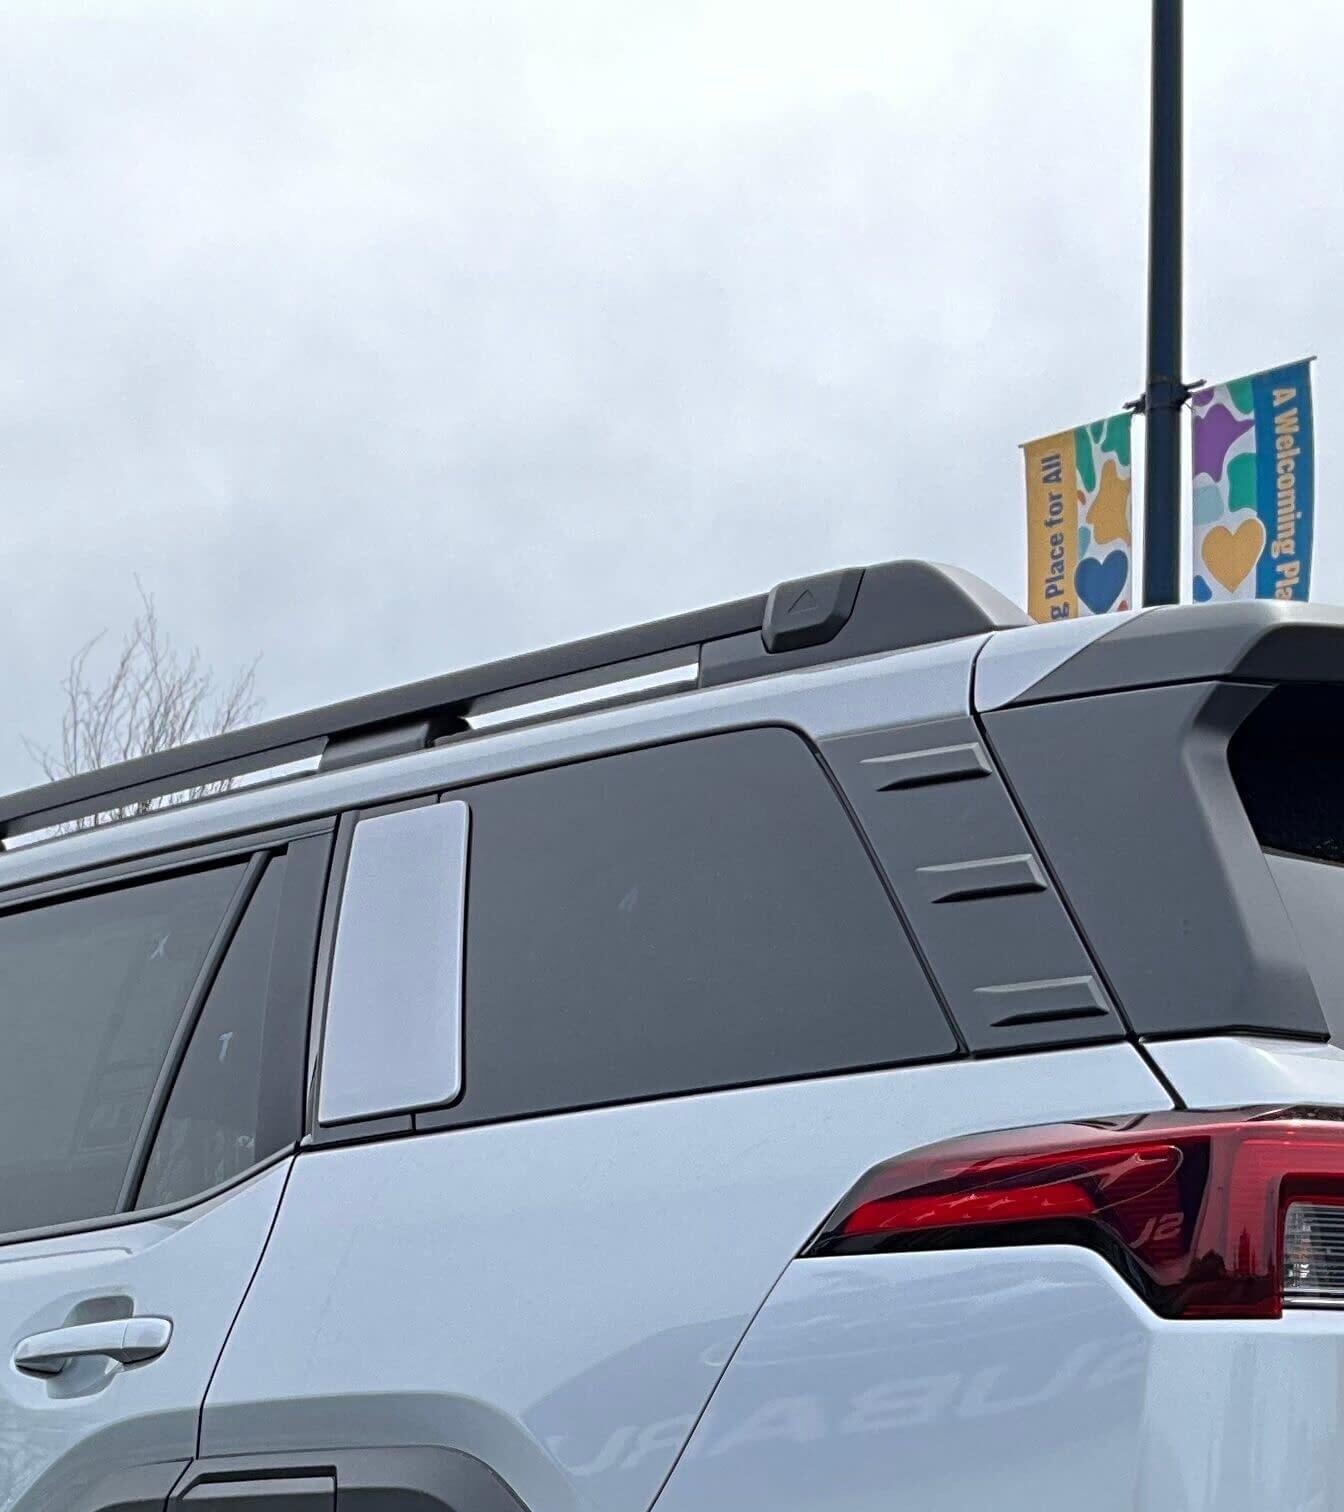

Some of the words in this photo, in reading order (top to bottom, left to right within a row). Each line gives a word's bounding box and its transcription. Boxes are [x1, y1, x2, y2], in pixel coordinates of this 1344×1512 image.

[1272, 387, 1297, 407] A
[1041, 452, 1063, 485] All
[1271, 407, 1301, 559] Welcoming
[1044, 490, 1065, 529] for
[1044, 531, 1065, 600] Place
